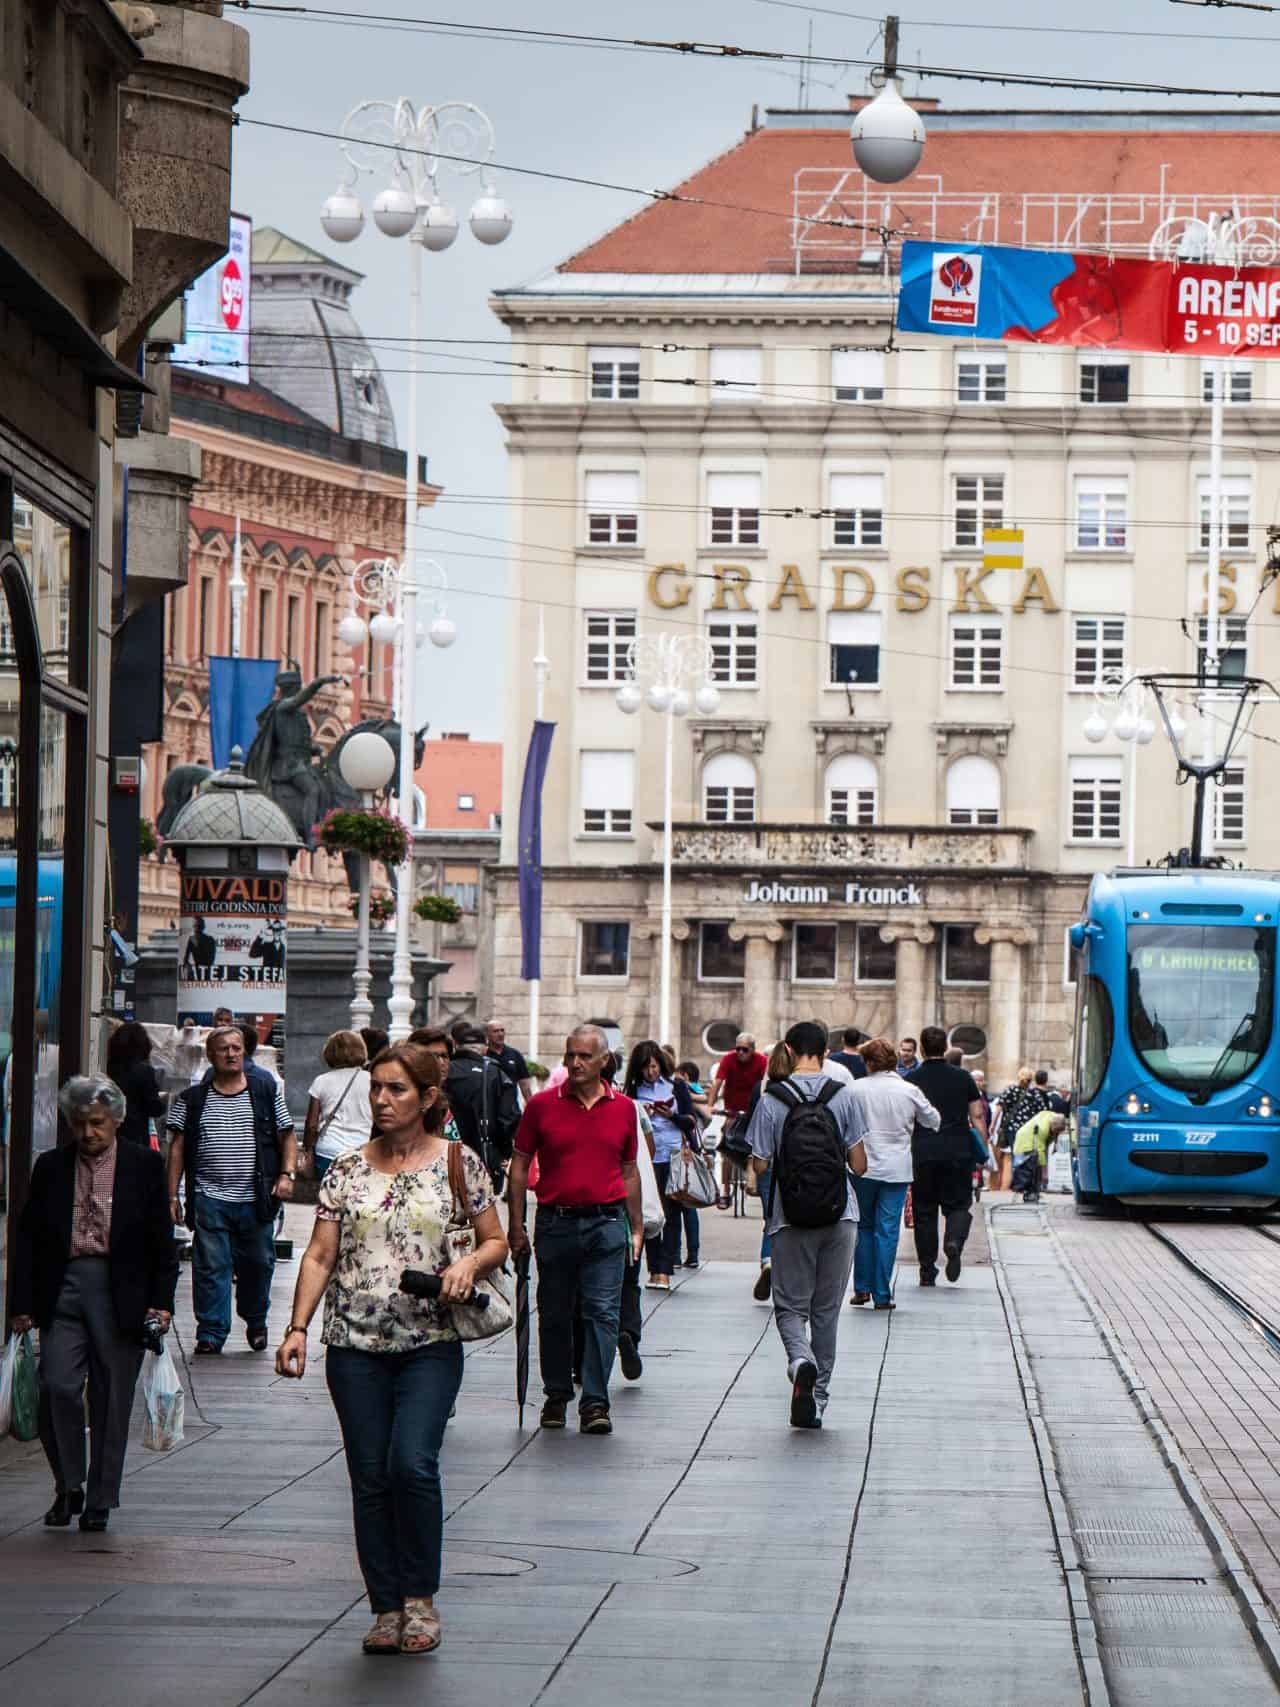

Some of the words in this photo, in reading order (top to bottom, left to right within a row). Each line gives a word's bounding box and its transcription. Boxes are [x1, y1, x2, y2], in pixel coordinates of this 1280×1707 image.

[1184, 320, 1198, 344] 5
[1216, 322, 1240, 345] 10
[647, 563, 1062, 615] GRADSKA
[744, 881, 829, 904] Johann
[846, 883, 922, 905] Franck
